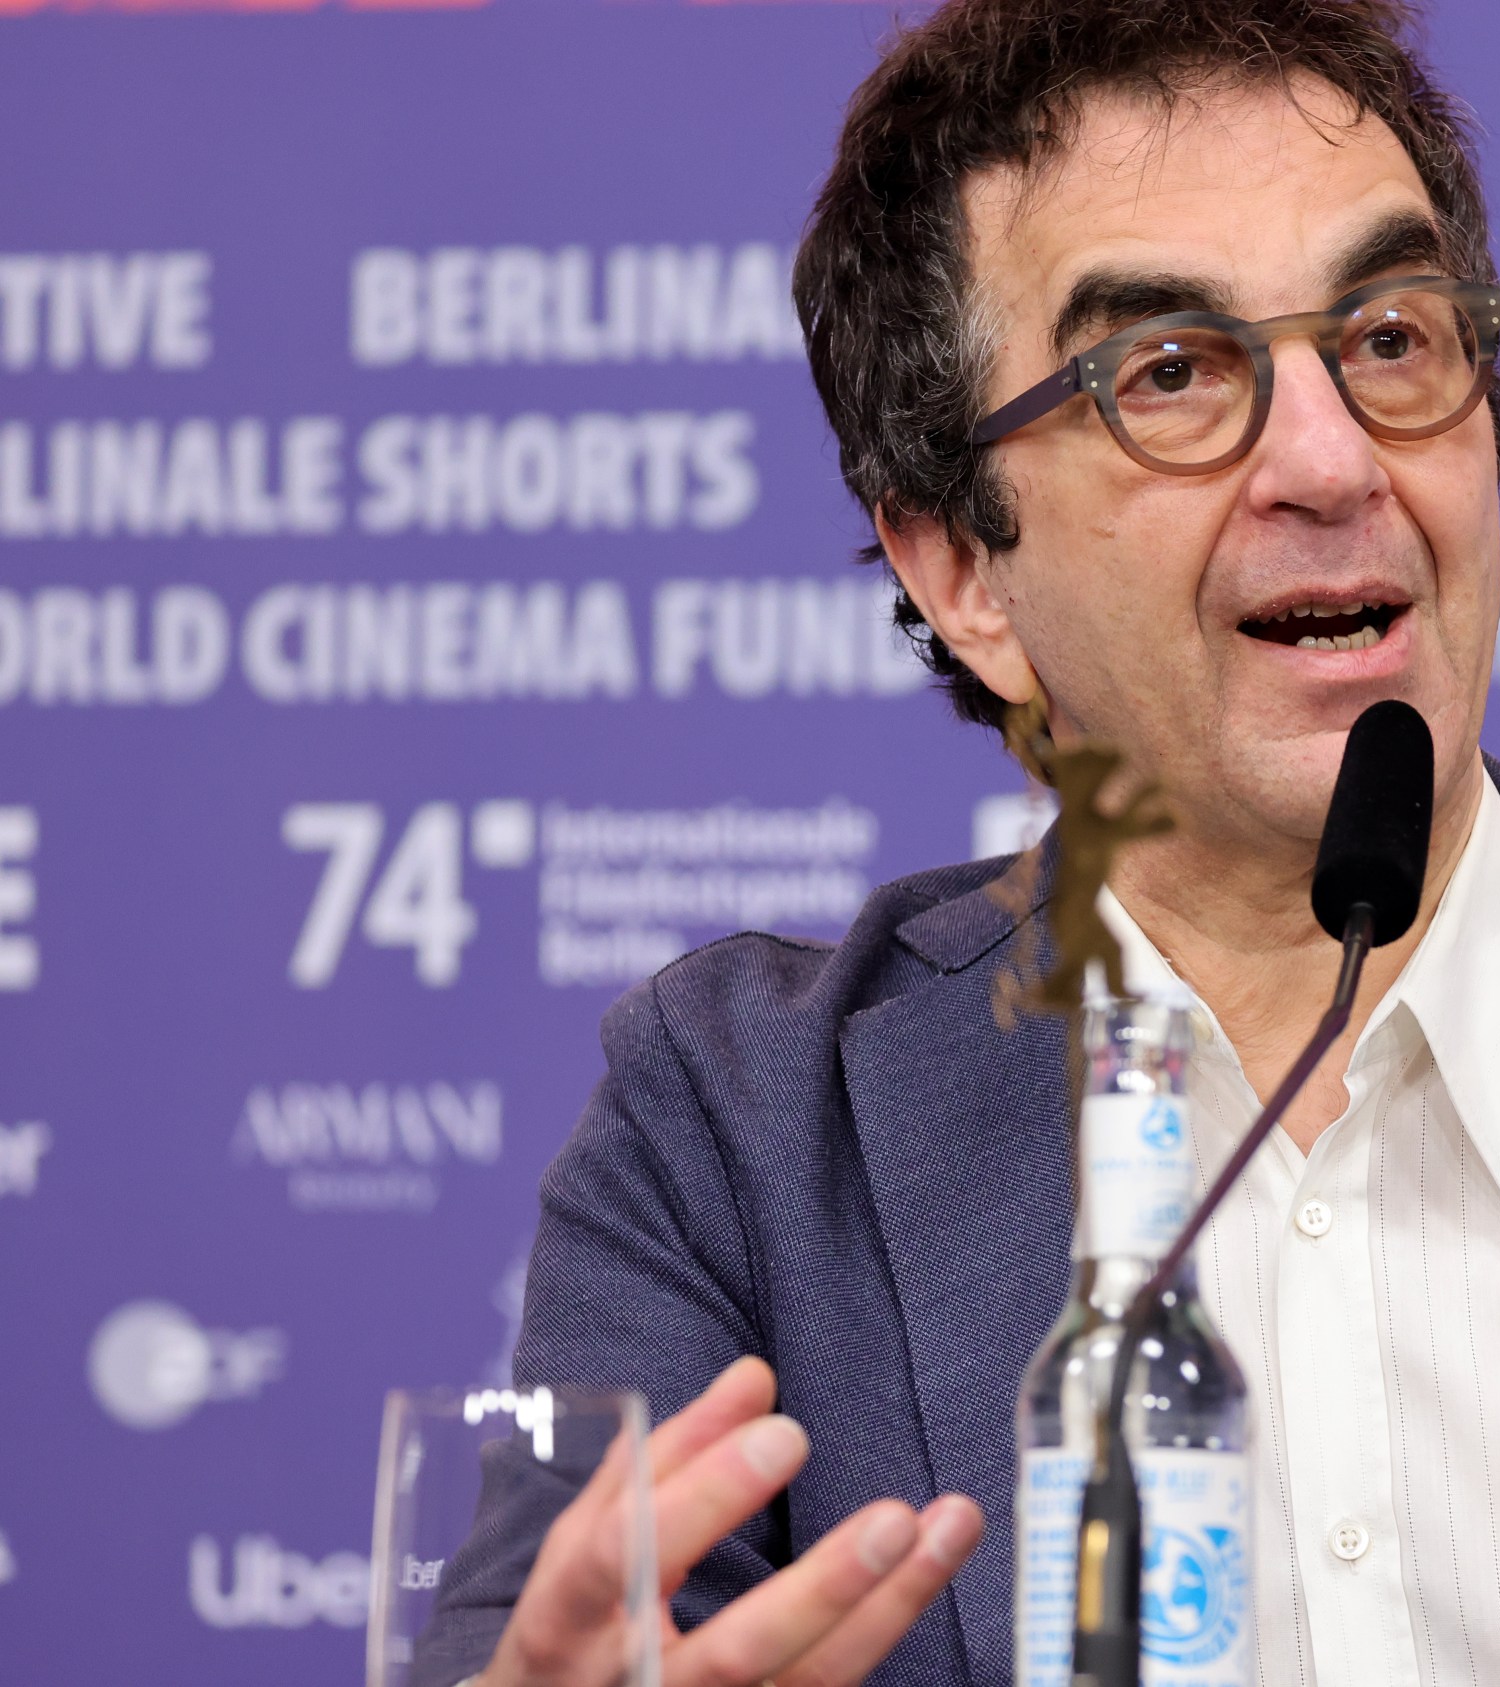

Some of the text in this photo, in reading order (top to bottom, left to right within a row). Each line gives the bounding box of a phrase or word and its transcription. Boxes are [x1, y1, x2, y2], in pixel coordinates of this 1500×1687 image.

[357, 411, 759, 533] SHORTS
[241, 580, 638, 703] CINEMA
[283, 802, 477, 988] 74
[190, 1533, 372, 1629] Ube
